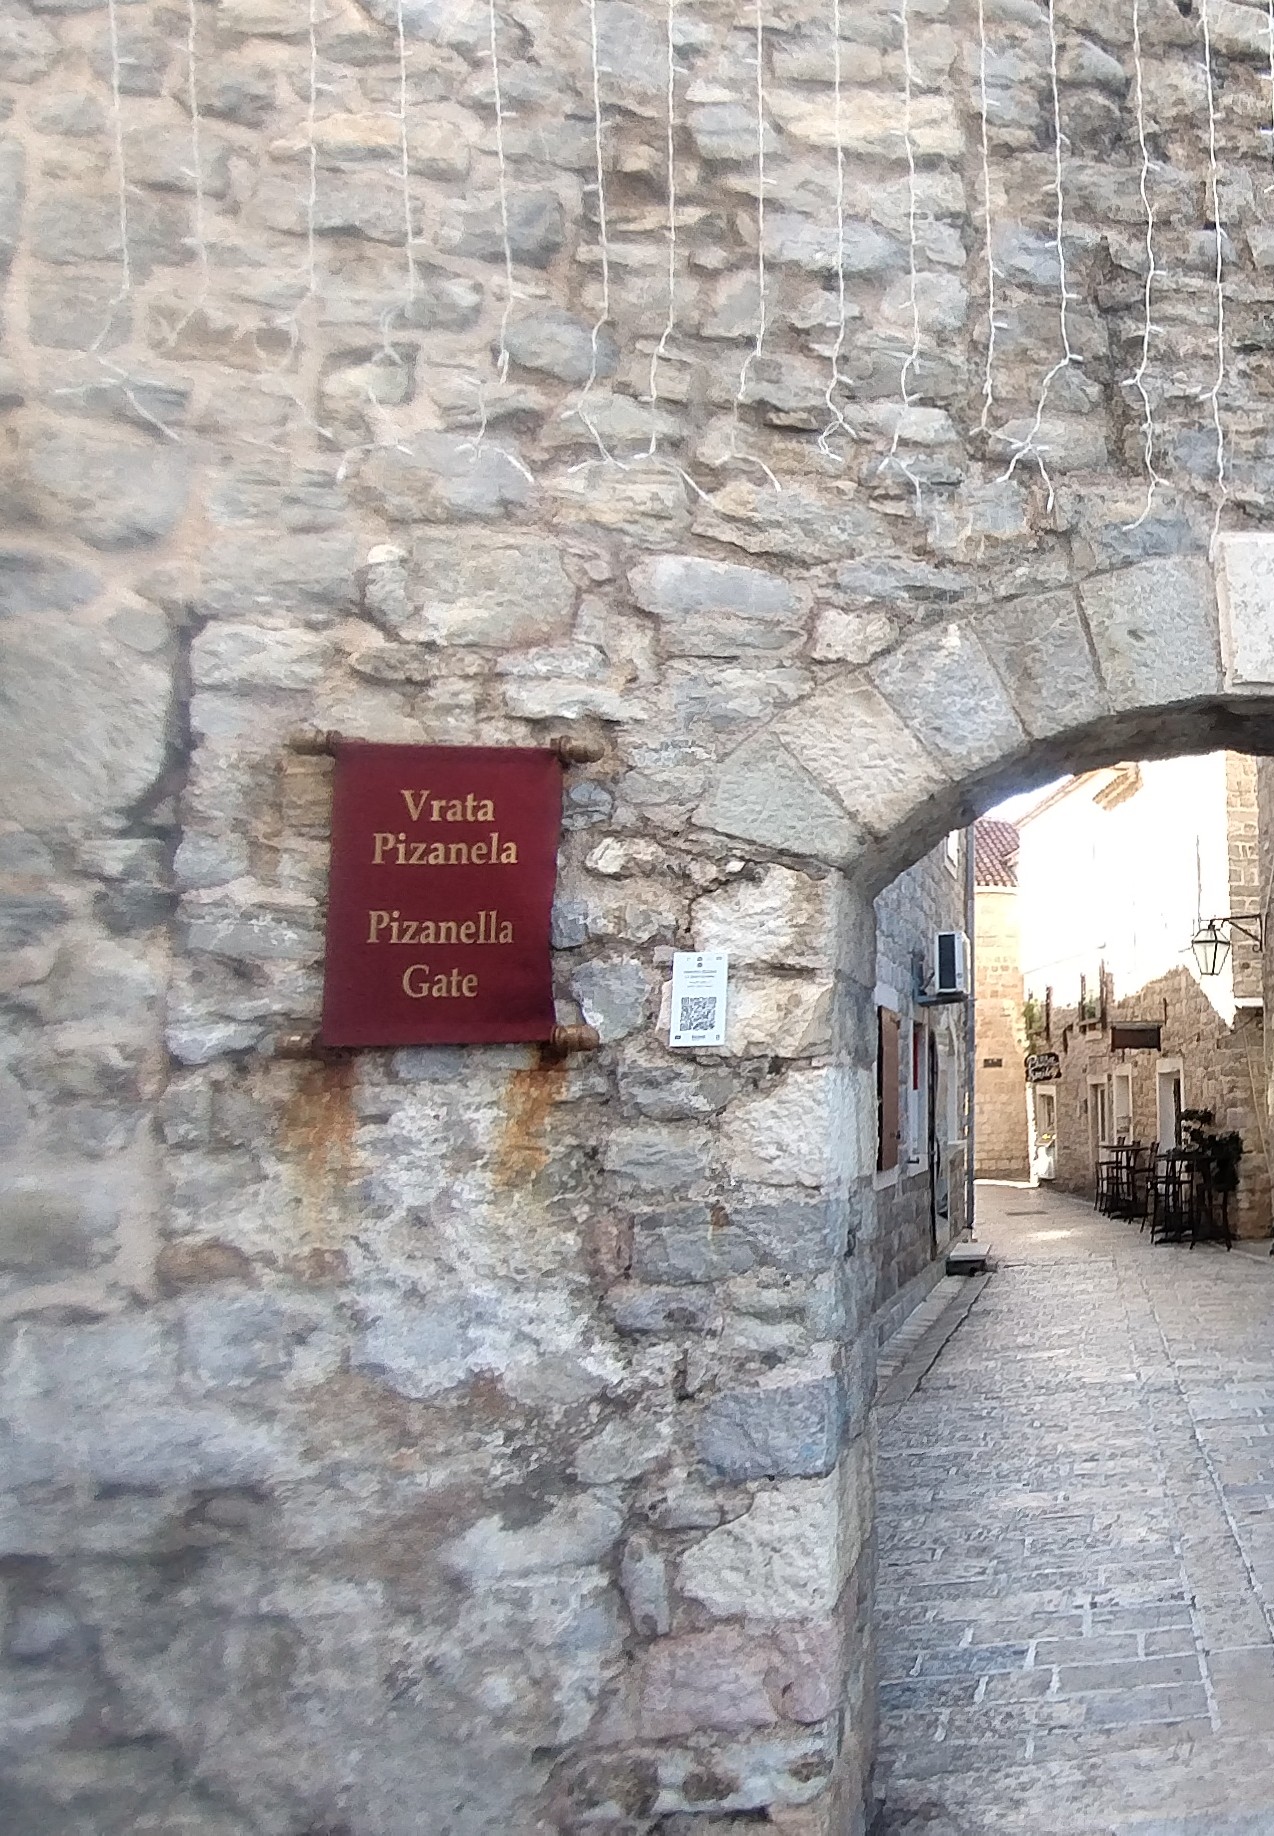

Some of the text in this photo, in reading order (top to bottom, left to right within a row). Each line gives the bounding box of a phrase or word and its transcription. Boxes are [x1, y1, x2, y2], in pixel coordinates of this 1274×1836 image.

[400, 789, 495, 822] Vrata
[371, 832, 518, 865] Pizanela
[366, 910, 514, 944] Pizanella
[402, 964, 479, 998] Gate
